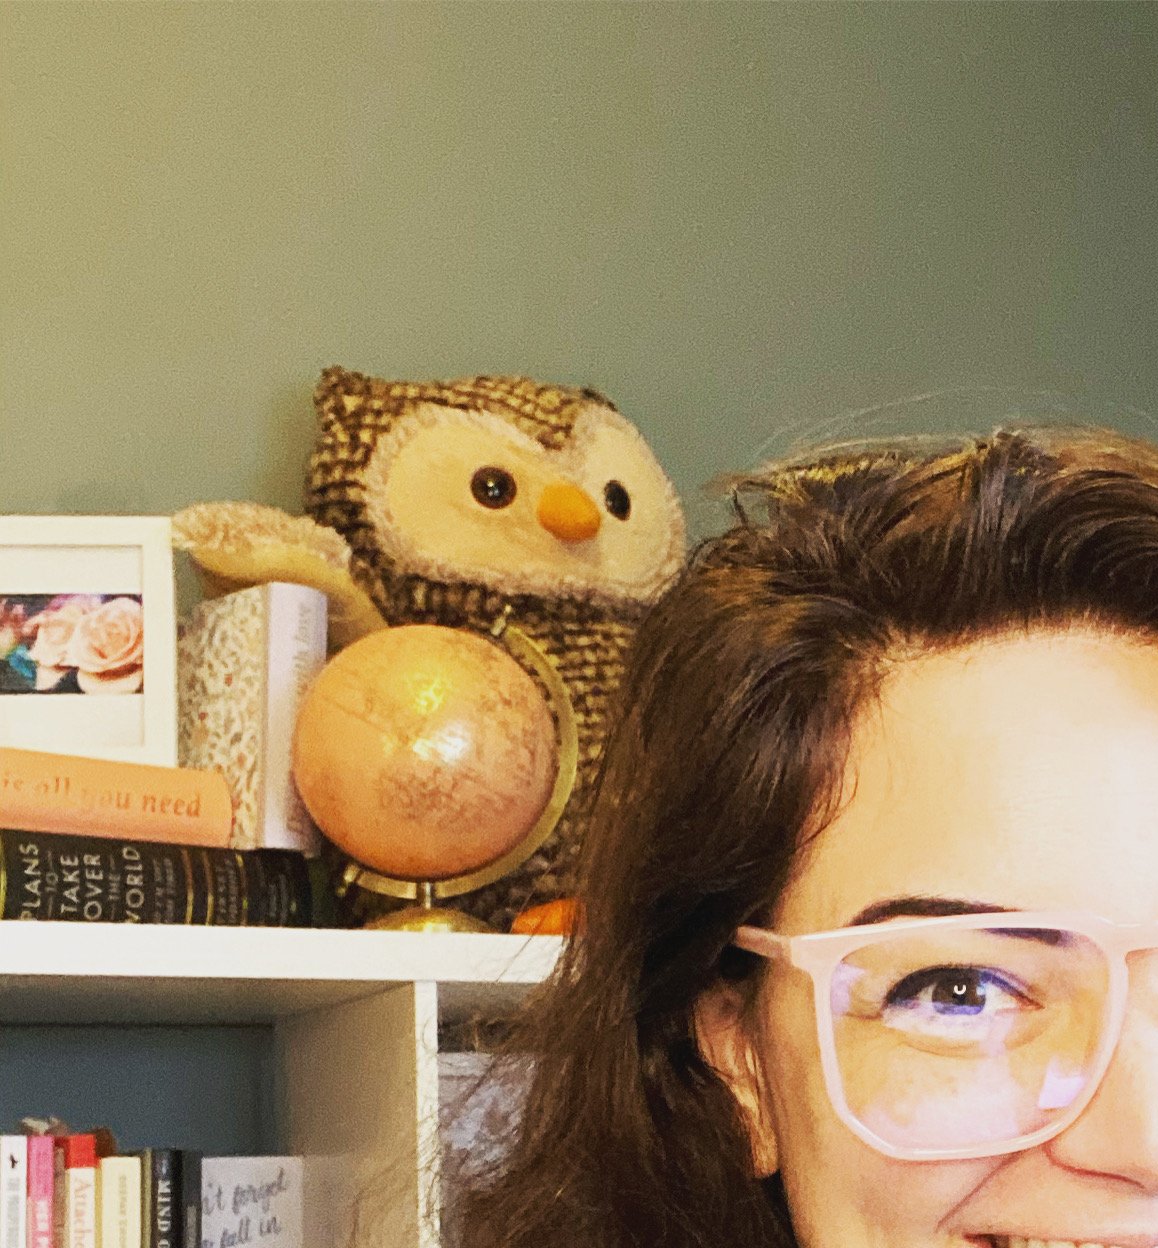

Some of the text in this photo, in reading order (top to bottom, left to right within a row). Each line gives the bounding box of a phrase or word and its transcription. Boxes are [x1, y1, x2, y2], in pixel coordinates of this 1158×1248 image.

[33, 776, 71, 797] all
[141, 790, 202, 819] need
[45, 871, 59, 893] TO
[60, 854, 81, 914] TAKE
[83, 853, 104, 921] OVER
[108, 873, 121, 901] THE
[157, 1179, 172, 1232] MIND
